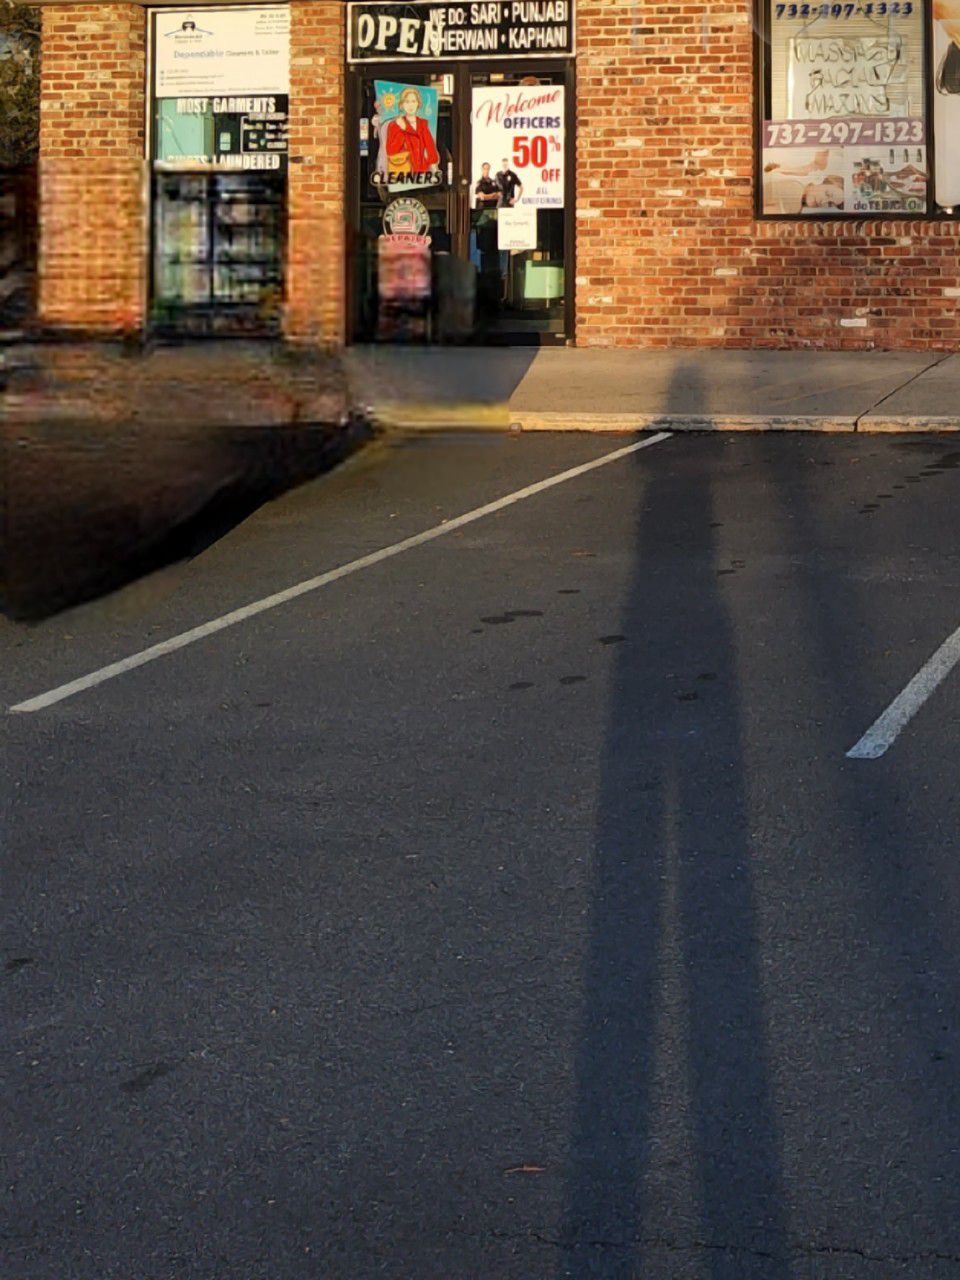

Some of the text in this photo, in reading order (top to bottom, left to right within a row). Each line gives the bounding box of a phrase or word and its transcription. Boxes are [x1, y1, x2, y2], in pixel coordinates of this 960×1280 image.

[471, 3, 500, 24] SARI
[512, 0, 568, 23] PUNJABI
[775, 2, 913, 18] 732-297-1323
[358, 13, 446, 58] OPEN
[509, 26, 567, 48] KAPHANI
[176, 97, 276, 113] MOST GARMENTS
[476, 89, 561, 126] Welcome
[503, 116, 561, 129] OFFICERS
[767, 122, 923, 146] 732-297-1323
[513, 135, 561, 168] 50%
[371, 170, 442, 185] CLEANERS
[541, 169, 560, 182] OFF
